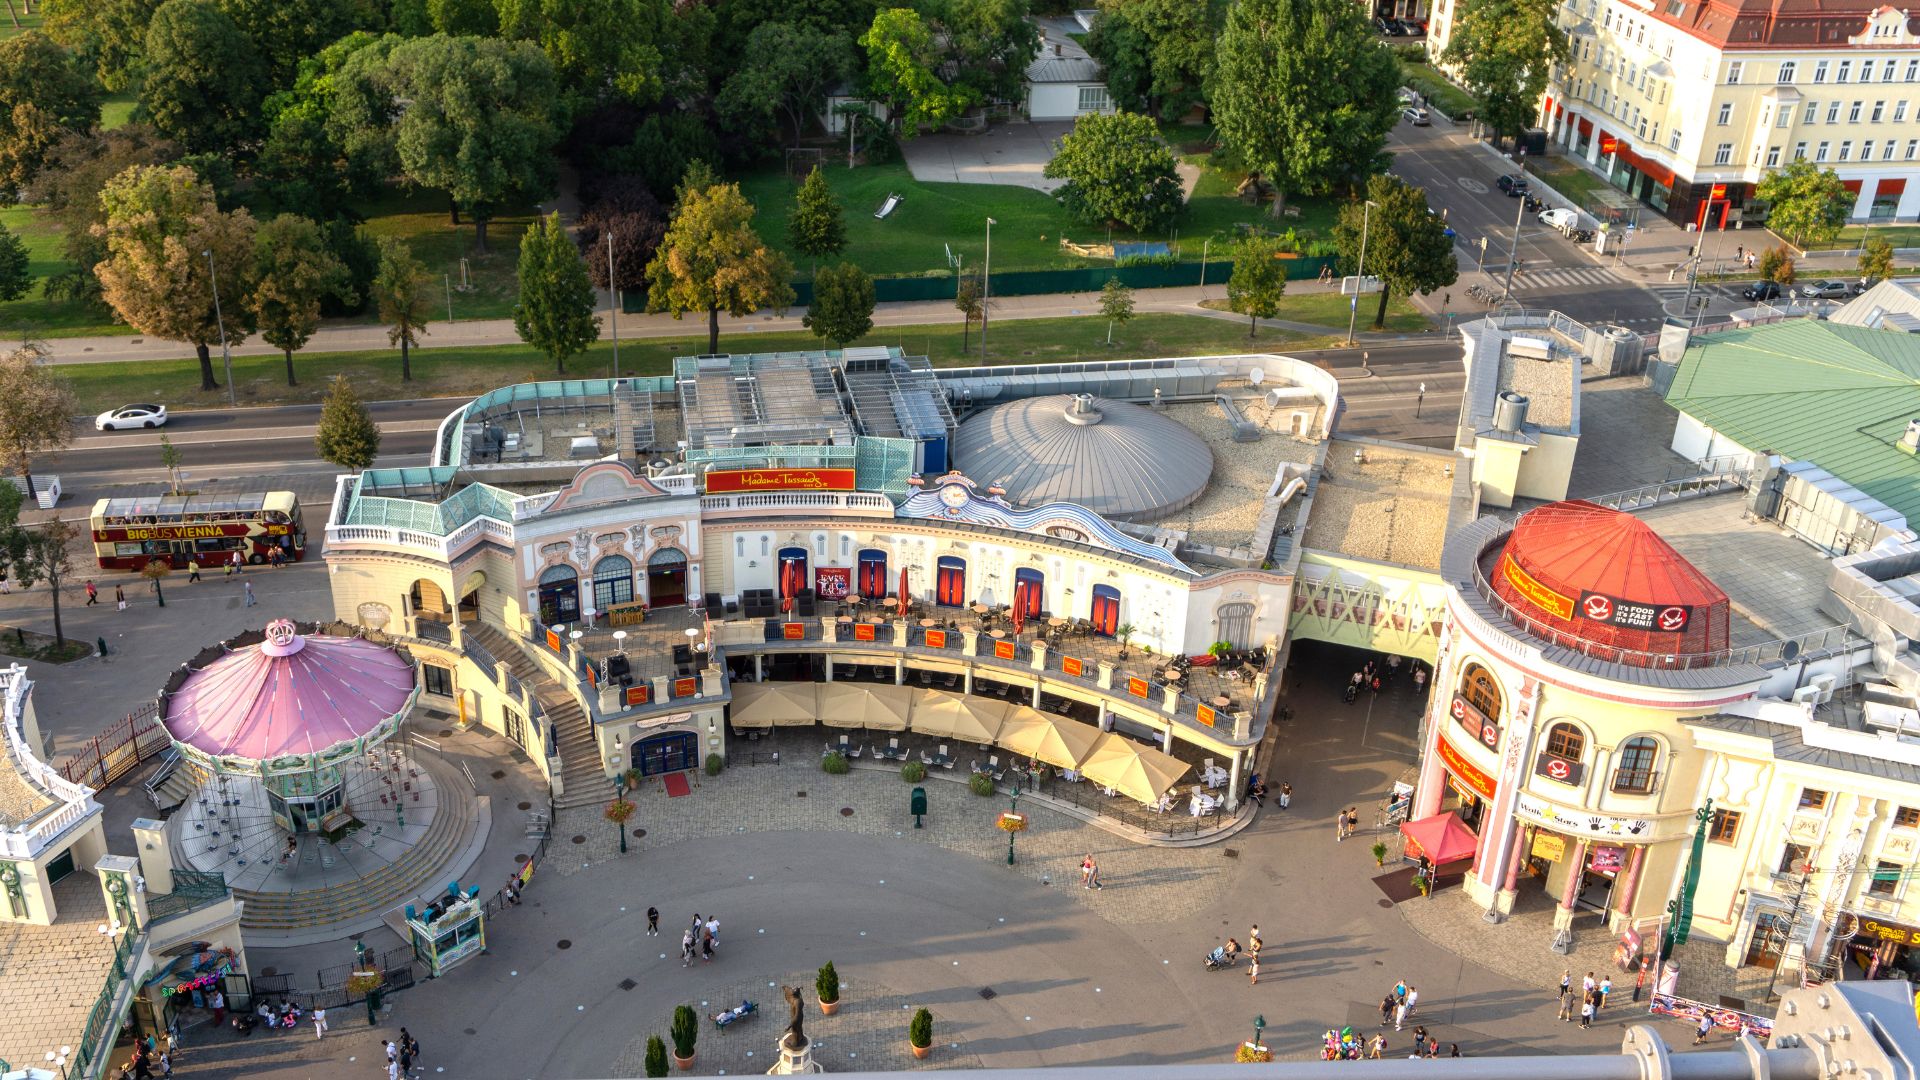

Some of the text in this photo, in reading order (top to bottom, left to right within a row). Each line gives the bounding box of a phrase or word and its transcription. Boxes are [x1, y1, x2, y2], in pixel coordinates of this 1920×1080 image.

[741, 472, 823, 488] Madame Tussauds
[174, 526, 224, 538] VIENNA
[1630, 606, 1655, 615] FOOD
[1629, 612, 1654, 621] FAST
[1627, 618, 1652, 627] FUN!!
[1520, 802, 1579, 827] Walk Stars
